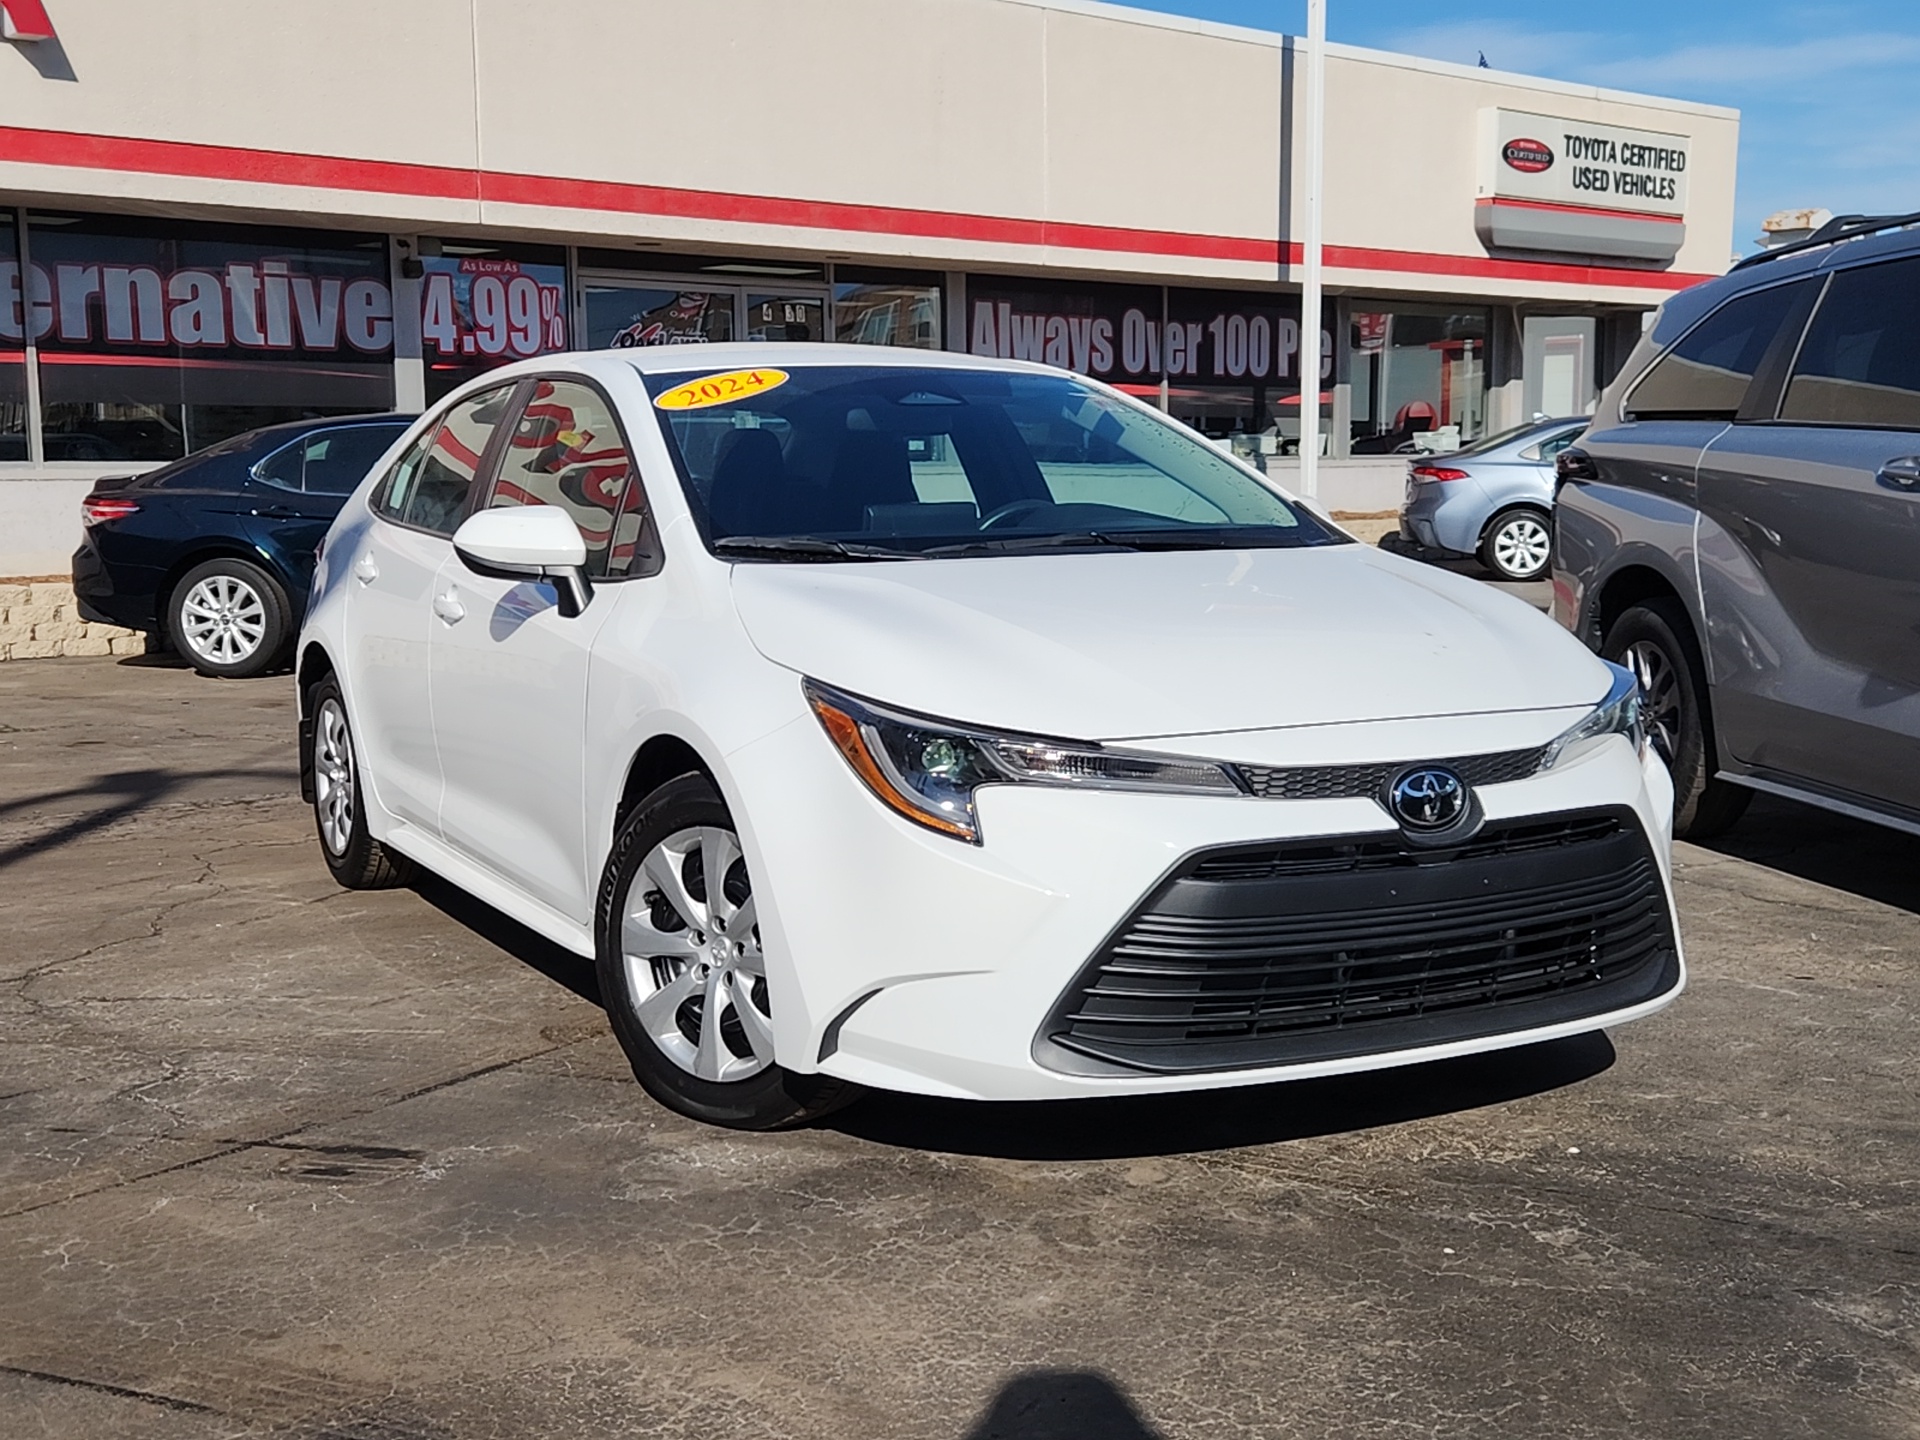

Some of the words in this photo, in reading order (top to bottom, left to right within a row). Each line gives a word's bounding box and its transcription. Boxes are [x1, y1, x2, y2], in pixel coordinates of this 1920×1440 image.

[1564, 134, 1617, 164] TOYOTA
[1621, 142, 1686, 172] CERTIFIED
[1573, 165, 1610, 192] USED
[1613, 170, 1676, 200] VEHICLES
[462, 260, 476, 271] As
[479, 261, 502, 272] Low
[504, 262, 518, 272] As
[423, 275, 564, 355] 4.99%
[971, 301, 1113, 374] Always
[1122, 308, 1202, 374] Over
[1208, 314, 1270, 377] 100
[678, 371, 765, 406] 2024
